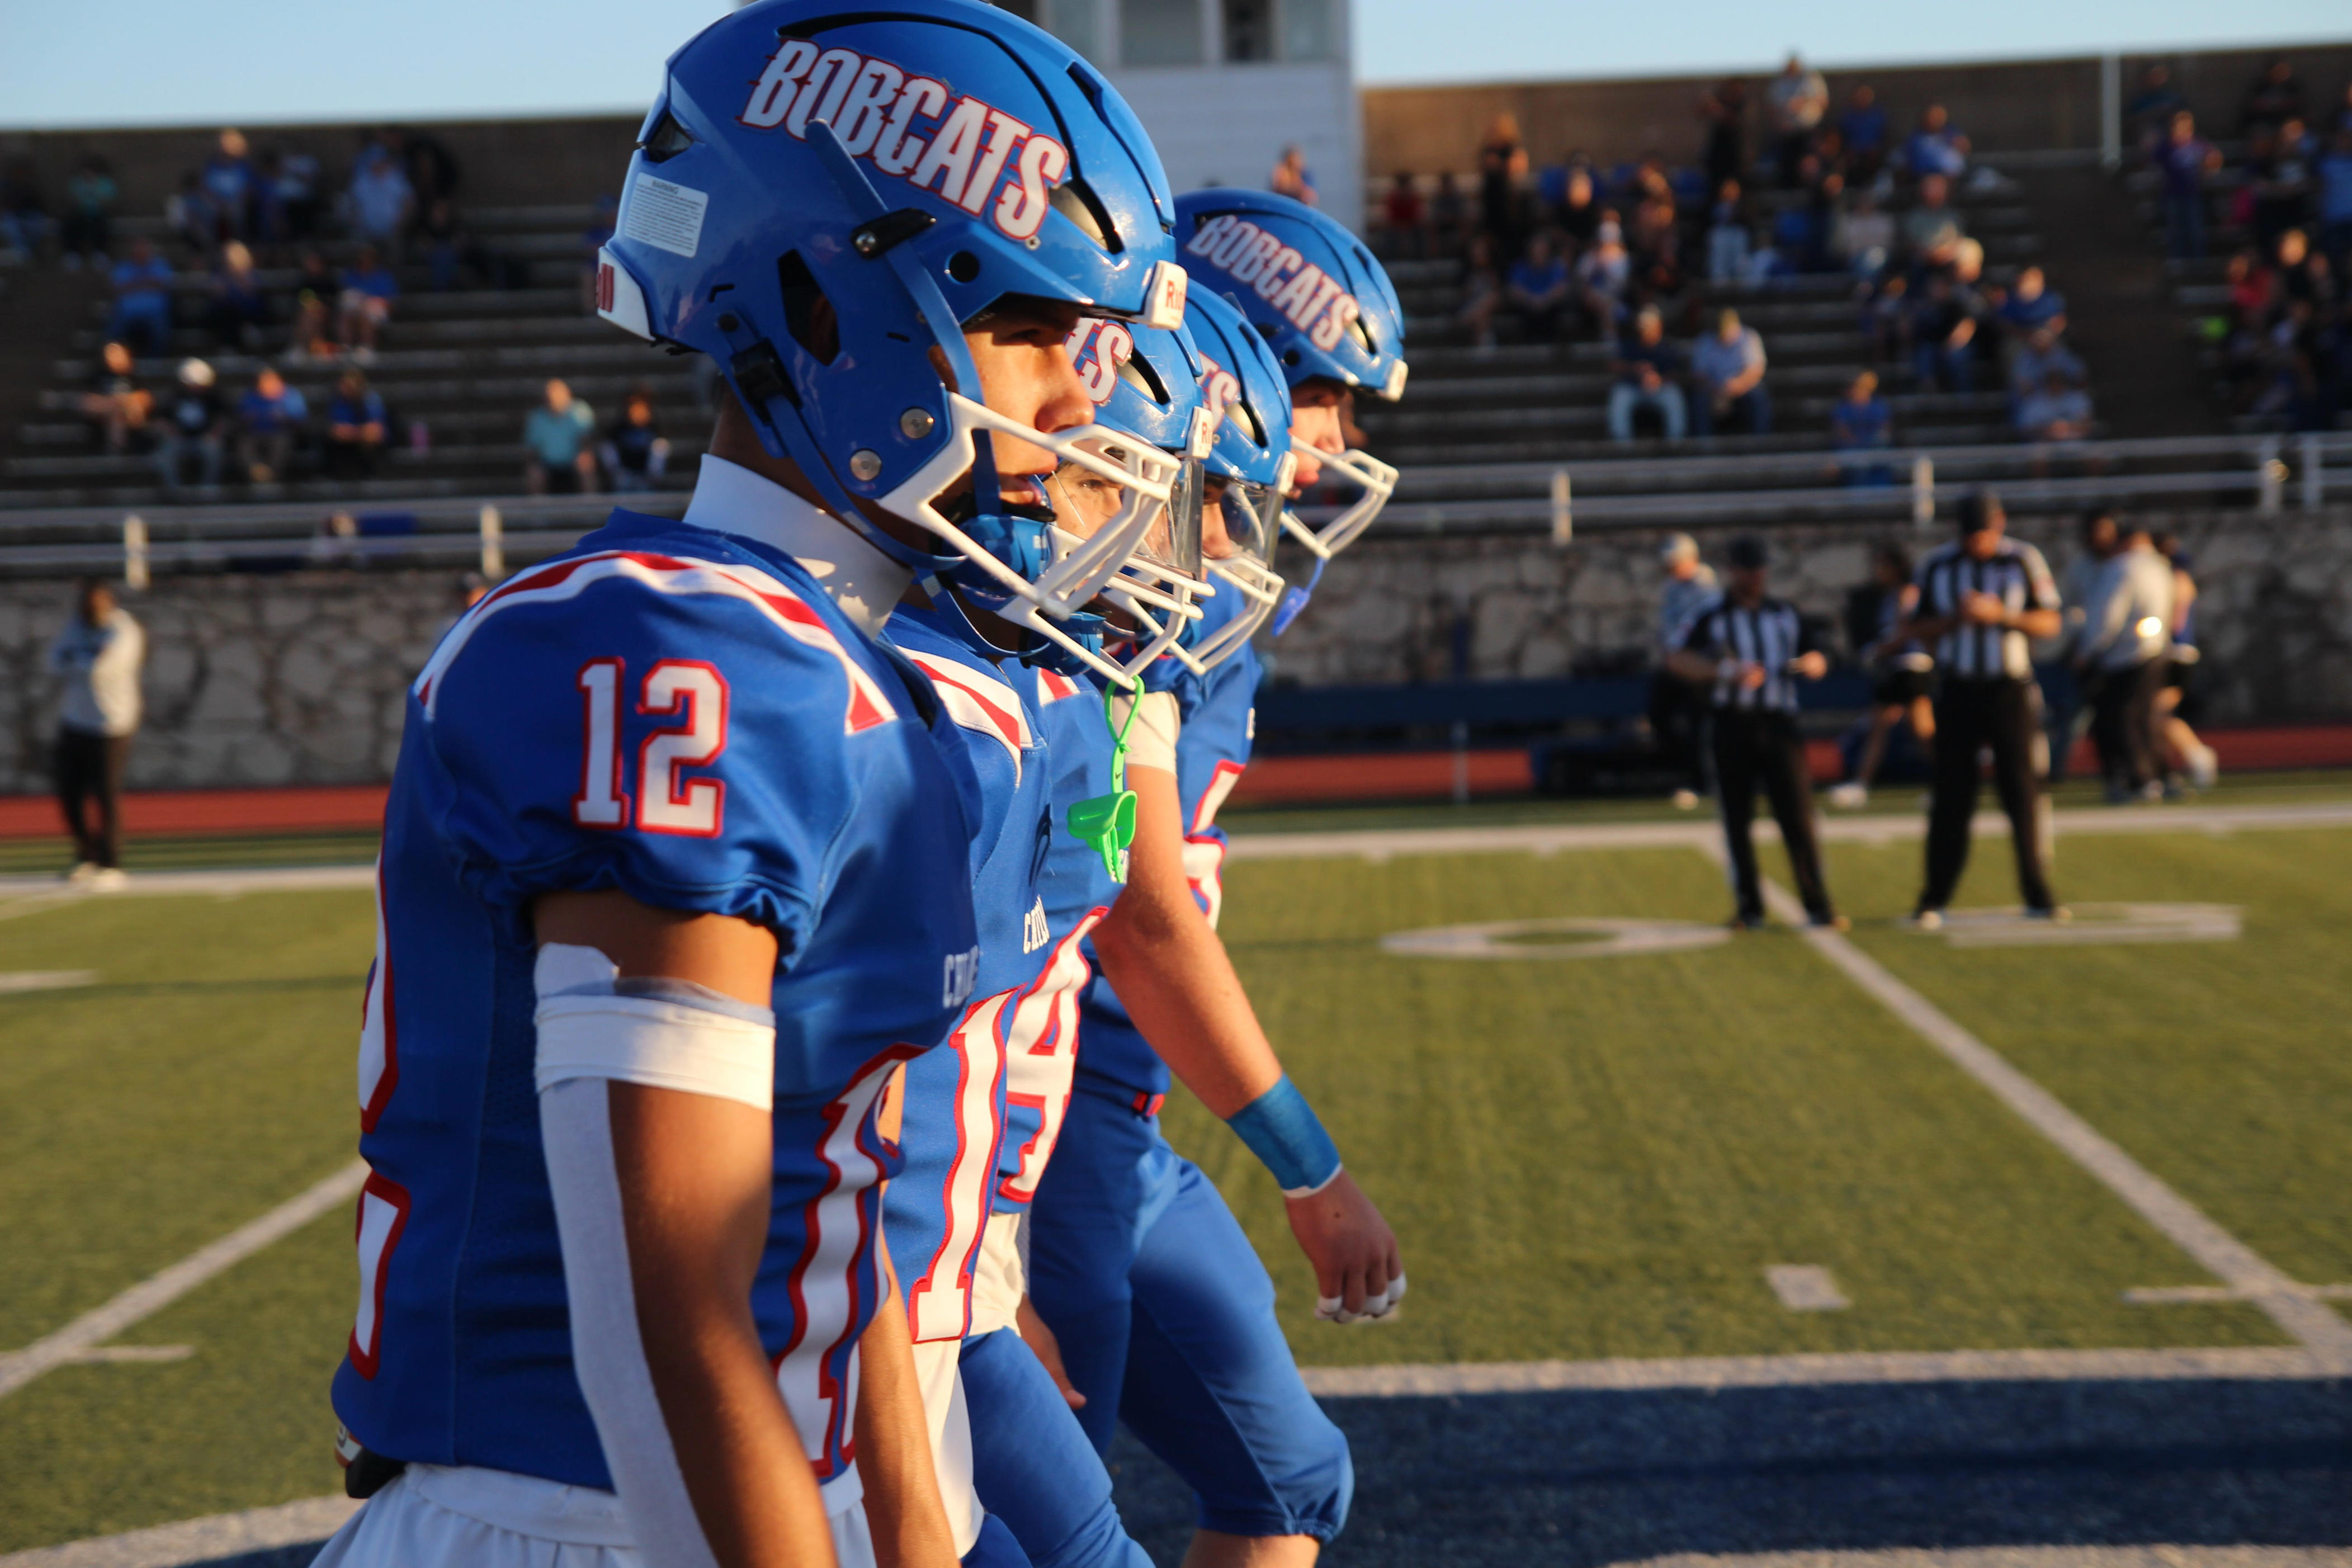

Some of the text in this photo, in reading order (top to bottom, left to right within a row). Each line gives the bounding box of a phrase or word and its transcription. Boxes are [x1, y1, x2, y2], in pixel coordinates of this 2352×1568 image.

[735, 37, 1069, 240] BOBCATS
[1186, 215, 1359, 352] BOBCATS
[572, 656, 730, 839] 12
[773, 1042, 929, 1480] 1
